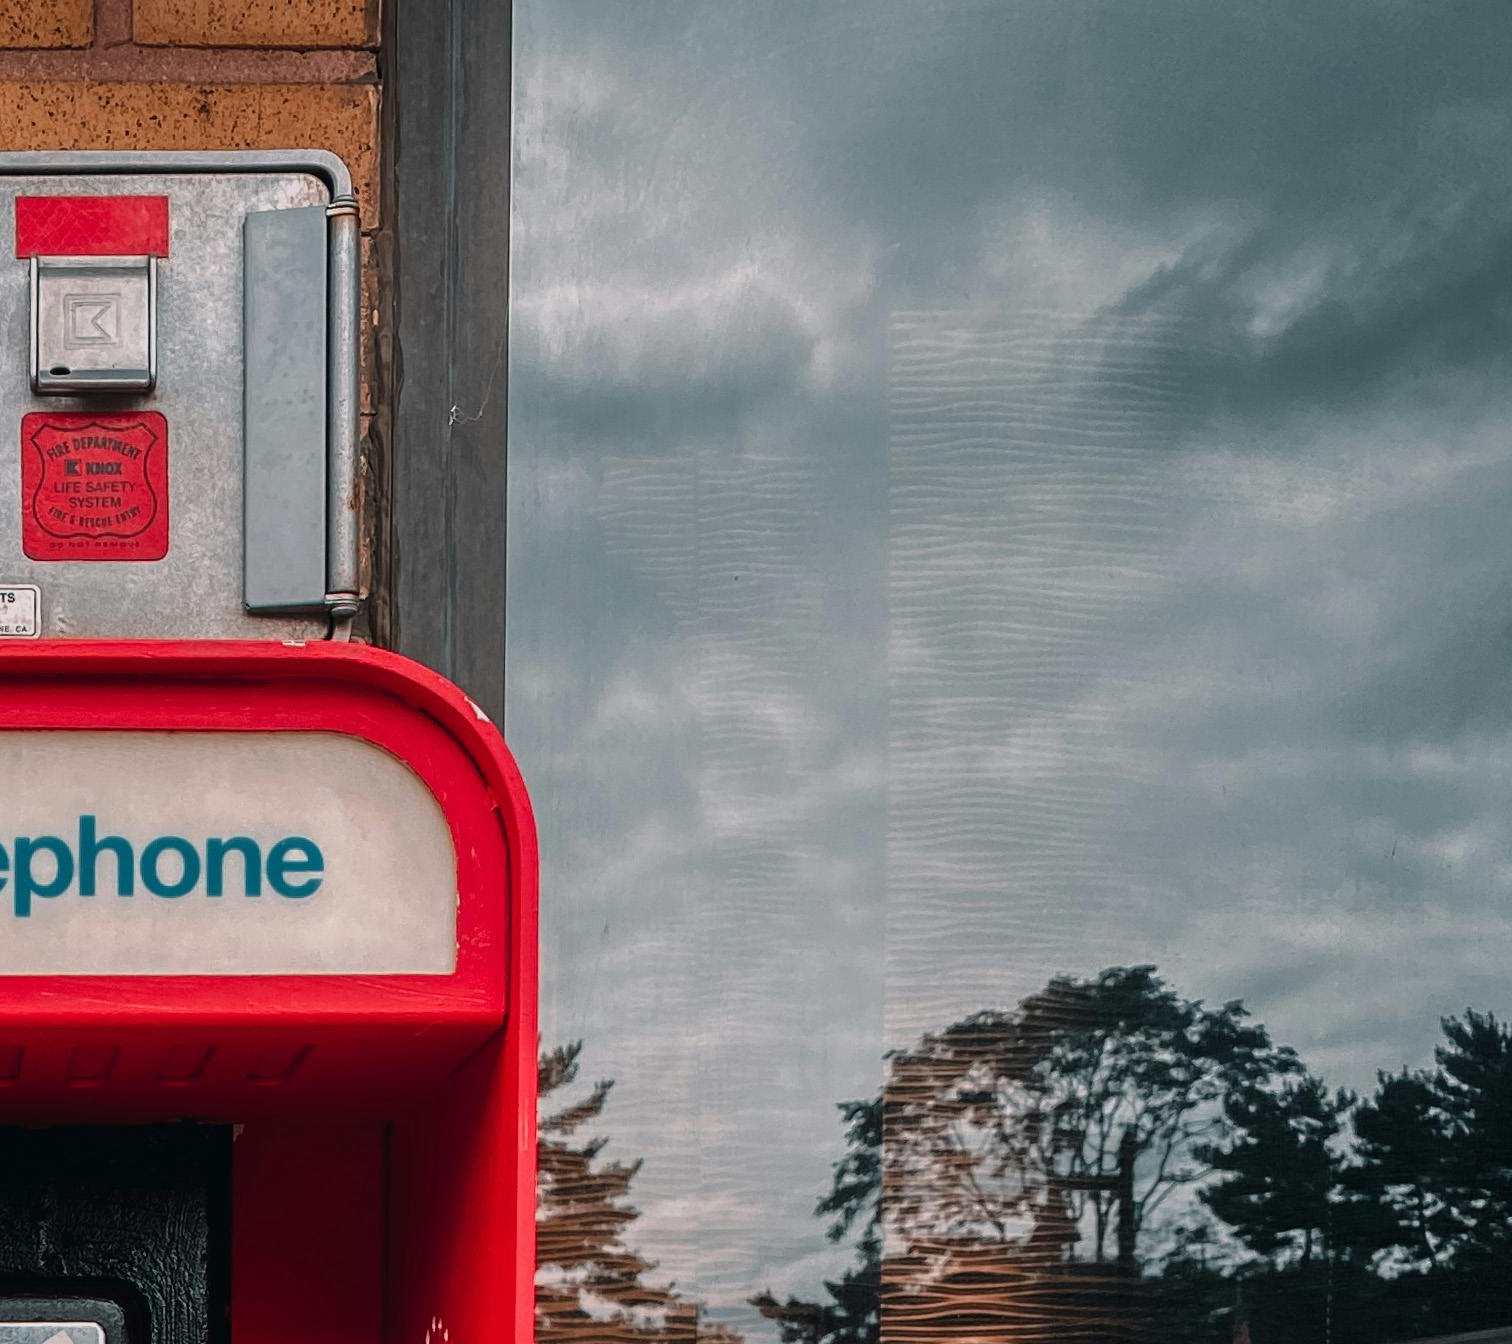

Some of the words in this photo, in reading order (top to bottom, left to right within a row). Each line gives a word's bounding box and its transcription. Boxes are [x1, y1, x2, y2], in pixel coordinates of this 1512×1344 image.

[47, 441, 70, 461] FIRE
[72, 437, 142, 460] DEPARTMENT
[86, 462, 122, 475] KNOX
[54, 481, 80, 493] LIFE
[86, 481, 136, 493] SAFETY
[68, 497, 122, 508] SYSTEM
[15, 625, 28, 633] CA
